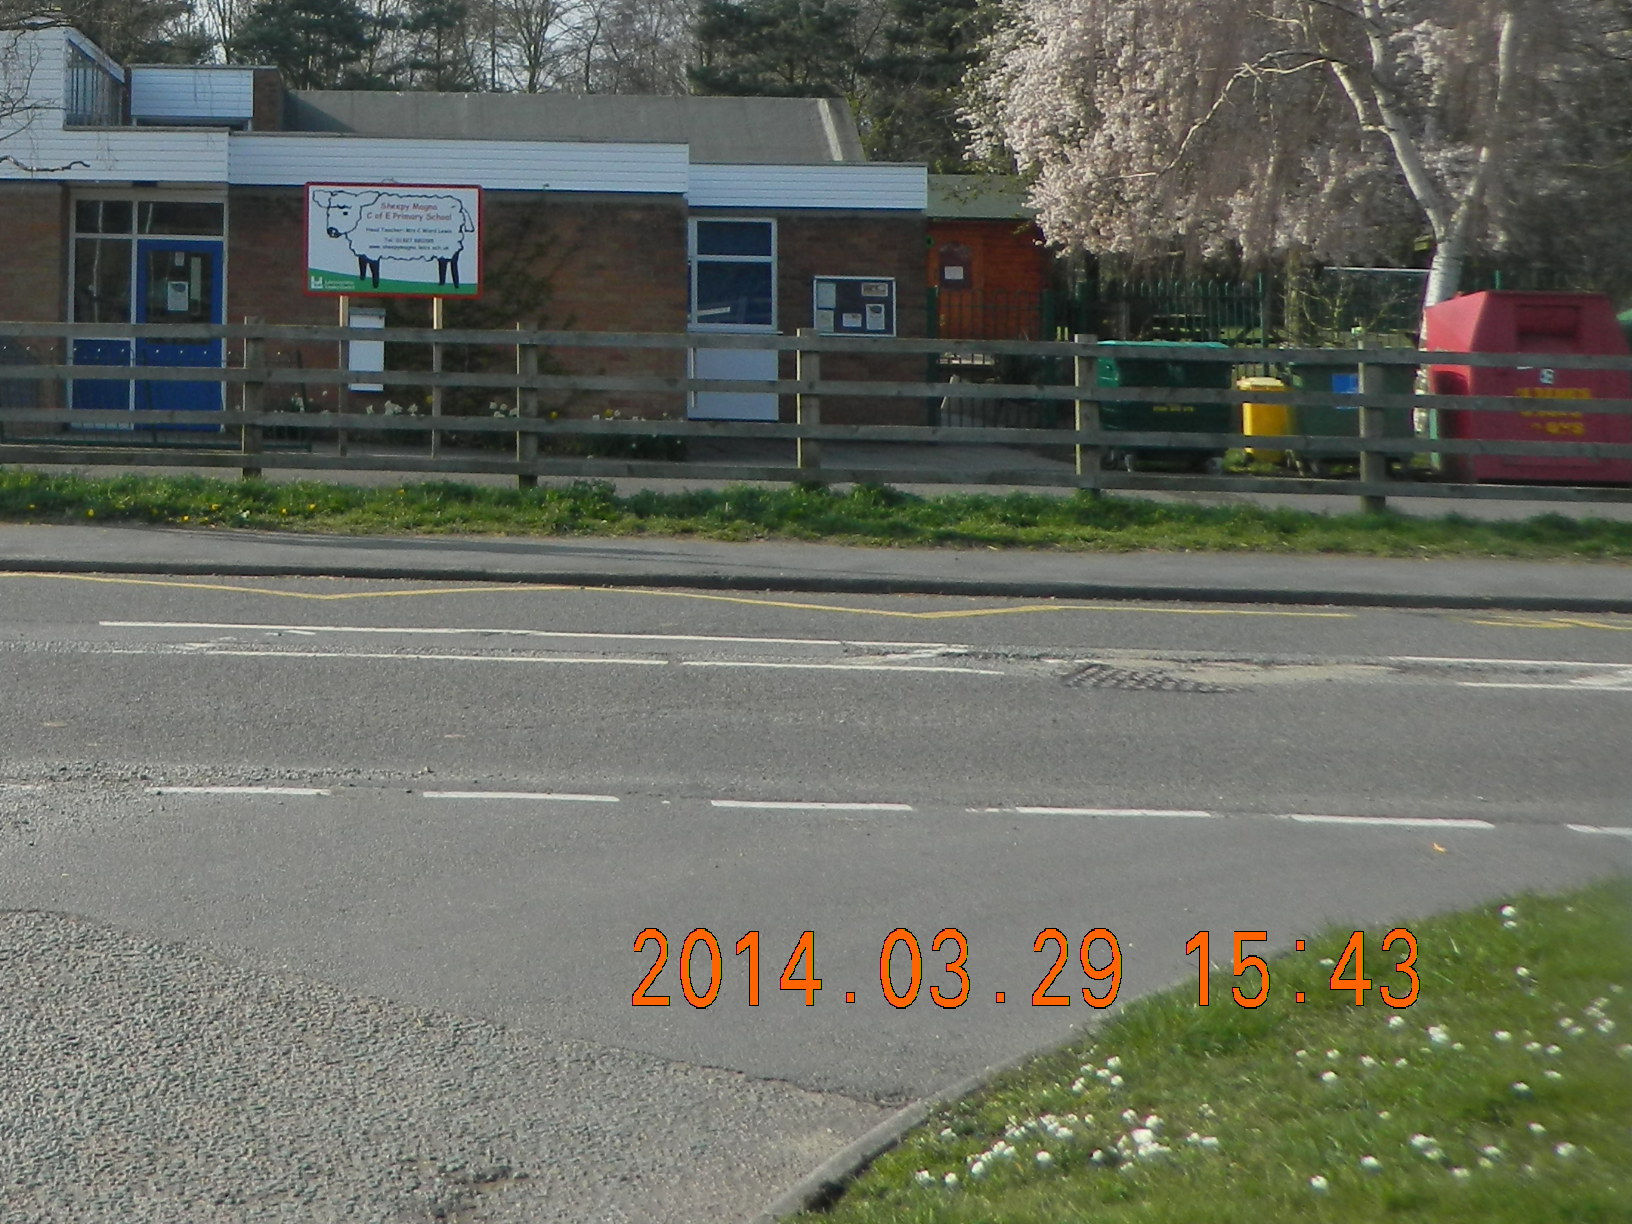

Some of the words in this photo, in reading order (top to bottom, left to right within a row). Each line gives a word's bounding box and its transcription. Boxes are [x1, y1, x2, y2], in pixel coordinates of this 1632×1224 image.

[381, 202, 410, 211] Sheepy
[412, 203, 438, 211] Magna
[366, 211, 373, 220] C
[375, 211, 384, 220] of
[385, 212, 391, 220] E
[392, 212, 423, 222] Primary
[426, 213, 452, 221] School
